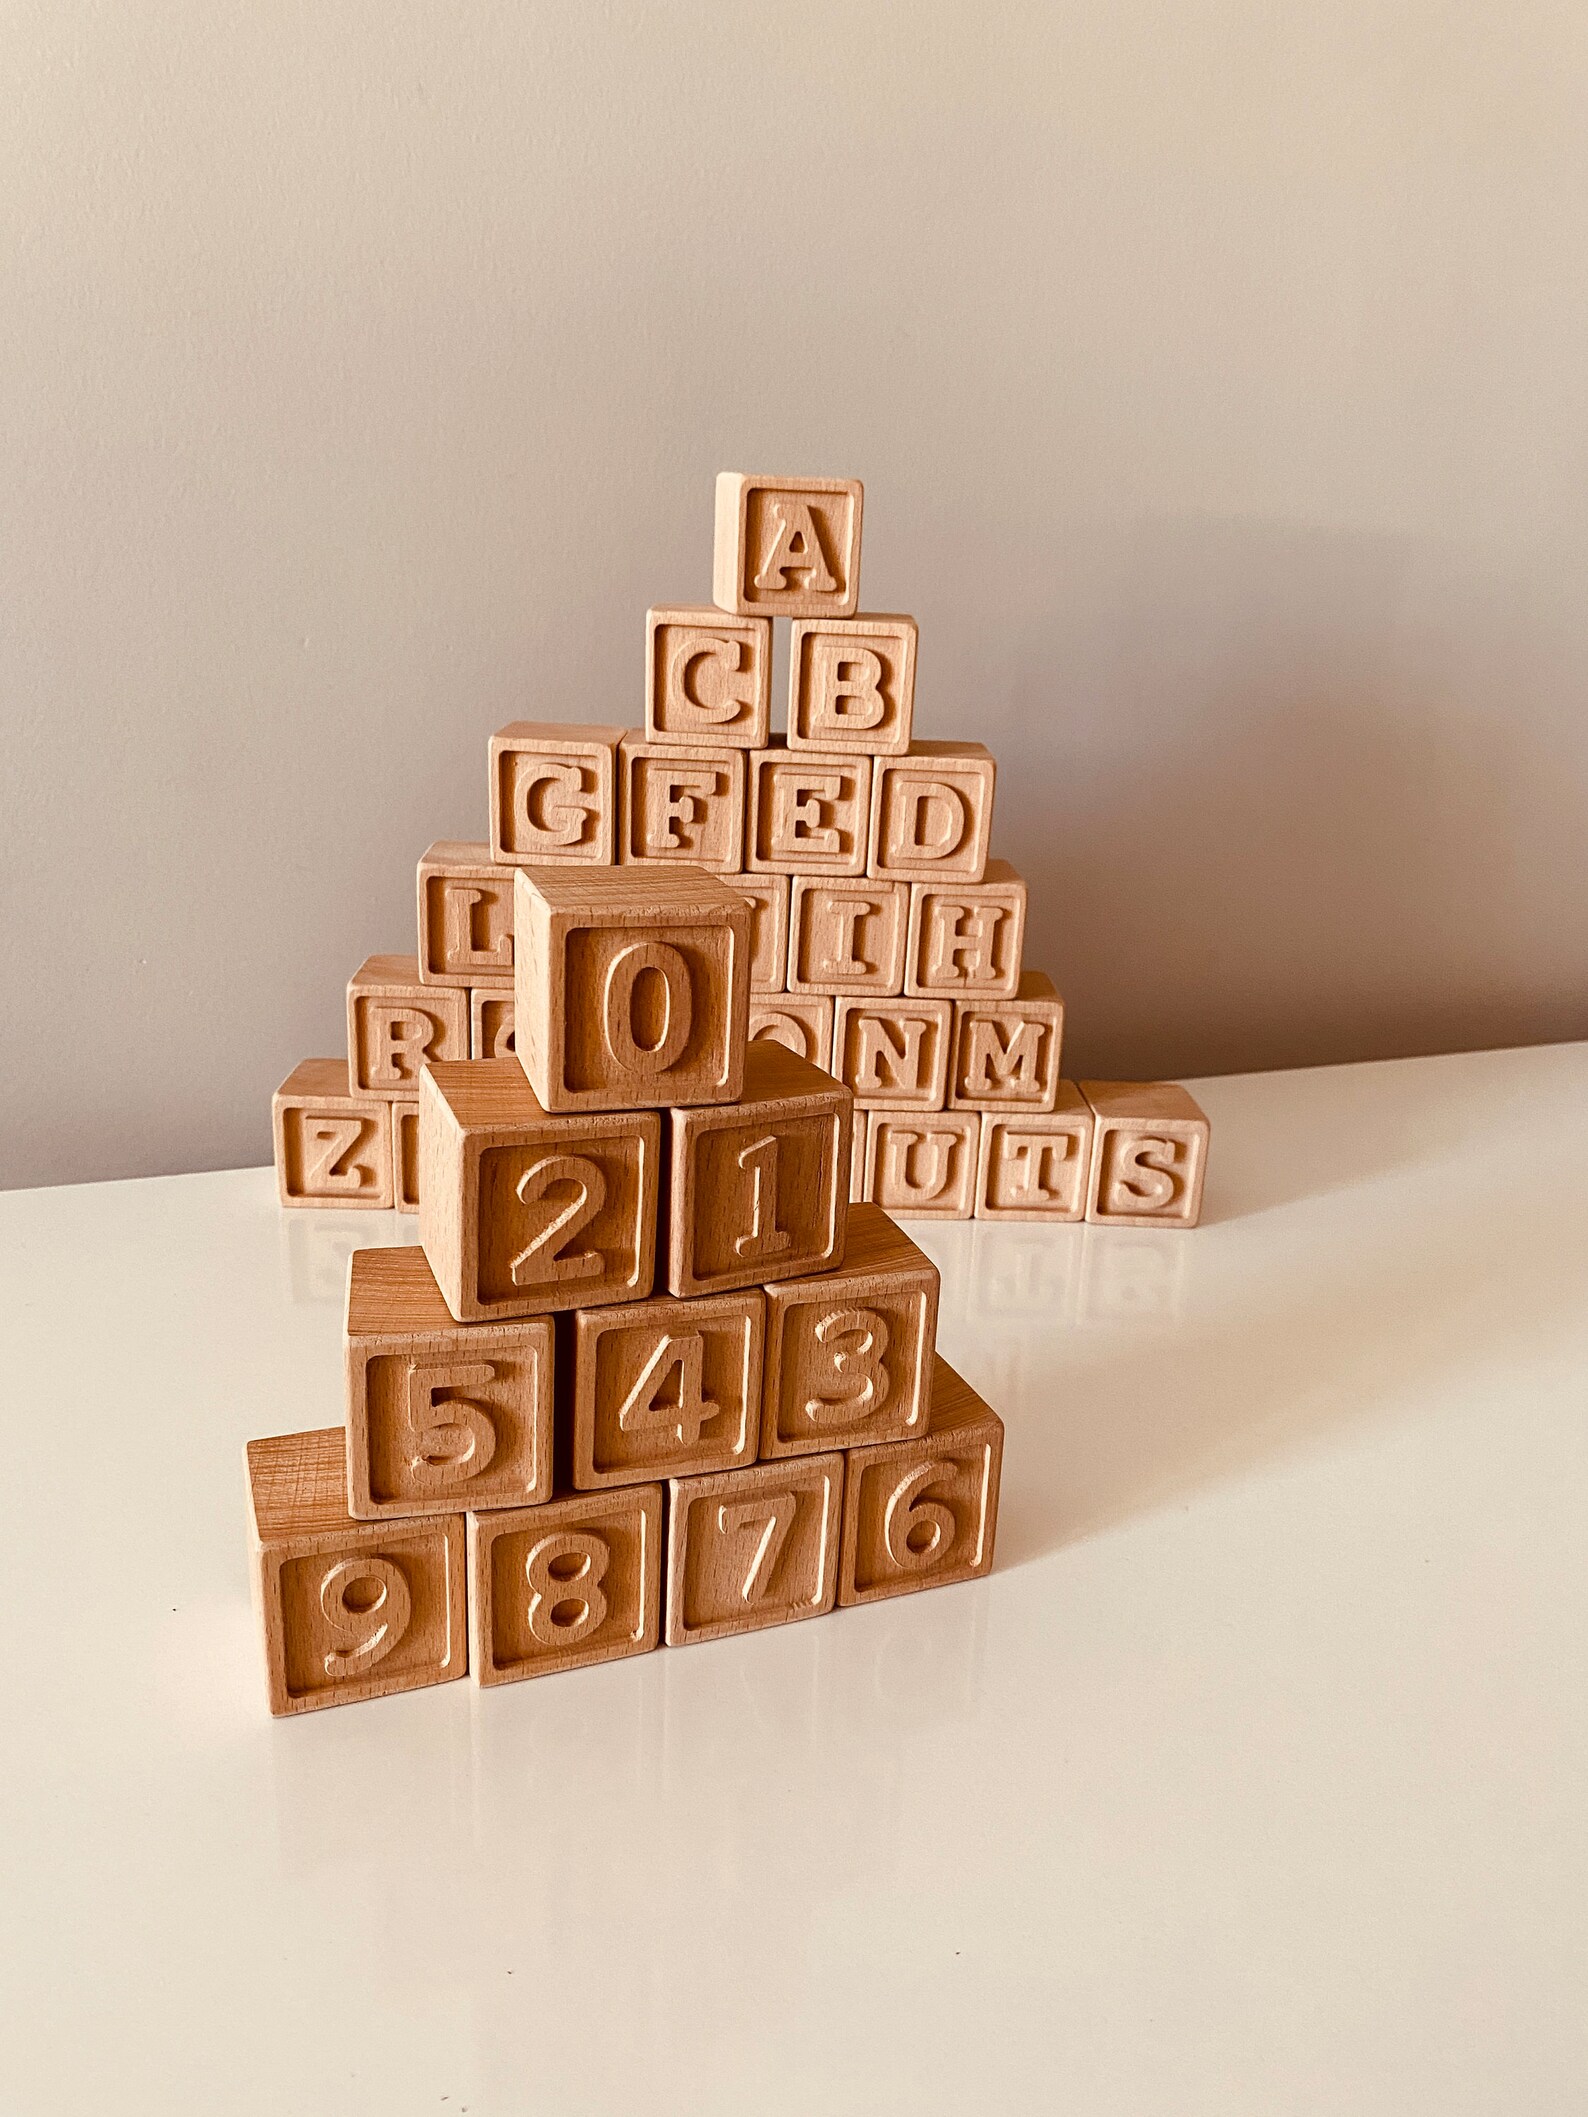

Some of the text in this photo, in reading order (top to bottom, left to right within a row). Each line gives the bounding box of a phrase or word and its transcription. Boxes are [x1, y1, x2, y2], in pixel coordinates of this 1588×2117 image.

[754, 505, 837, 591] A
[672, 637, 741, 724] C
[812, 646, 885, 730] B
[515, 764, 587, 846] G
[646, 770, 717, 849] F
[775, 774, 841, 854] E
[891, 782, 965, 860] D
[446, 888, 514, 966] L
[823, 901, 871, 975] I
[933, 905, 1003, 980] H
[371, 1006, 441, 1080] R
[856, 1017, 926, 1089] N
[966, 1020, 1045, 1091] M
[304, 1116, 366, 1190] Z
[890, 1131, 957, 1200] U
[1003, 1132, 1069, 1201] T
[1117, 1138, 1176, 1209] S
[511, 1154, 606, 1285] 2
[735, 1136, 792, 1258] 1
[619, 1332, 720, 1445] 4
[805, 1307, 889, 1425] 3
[407, 1360, 496, 1484] 5
[718, 1491, 795, 1603] 7
[886, 1461, 957, 1568] 6
[320, 1555, 410, 1677] 9
[526, 1531, 610, 1646] 8
